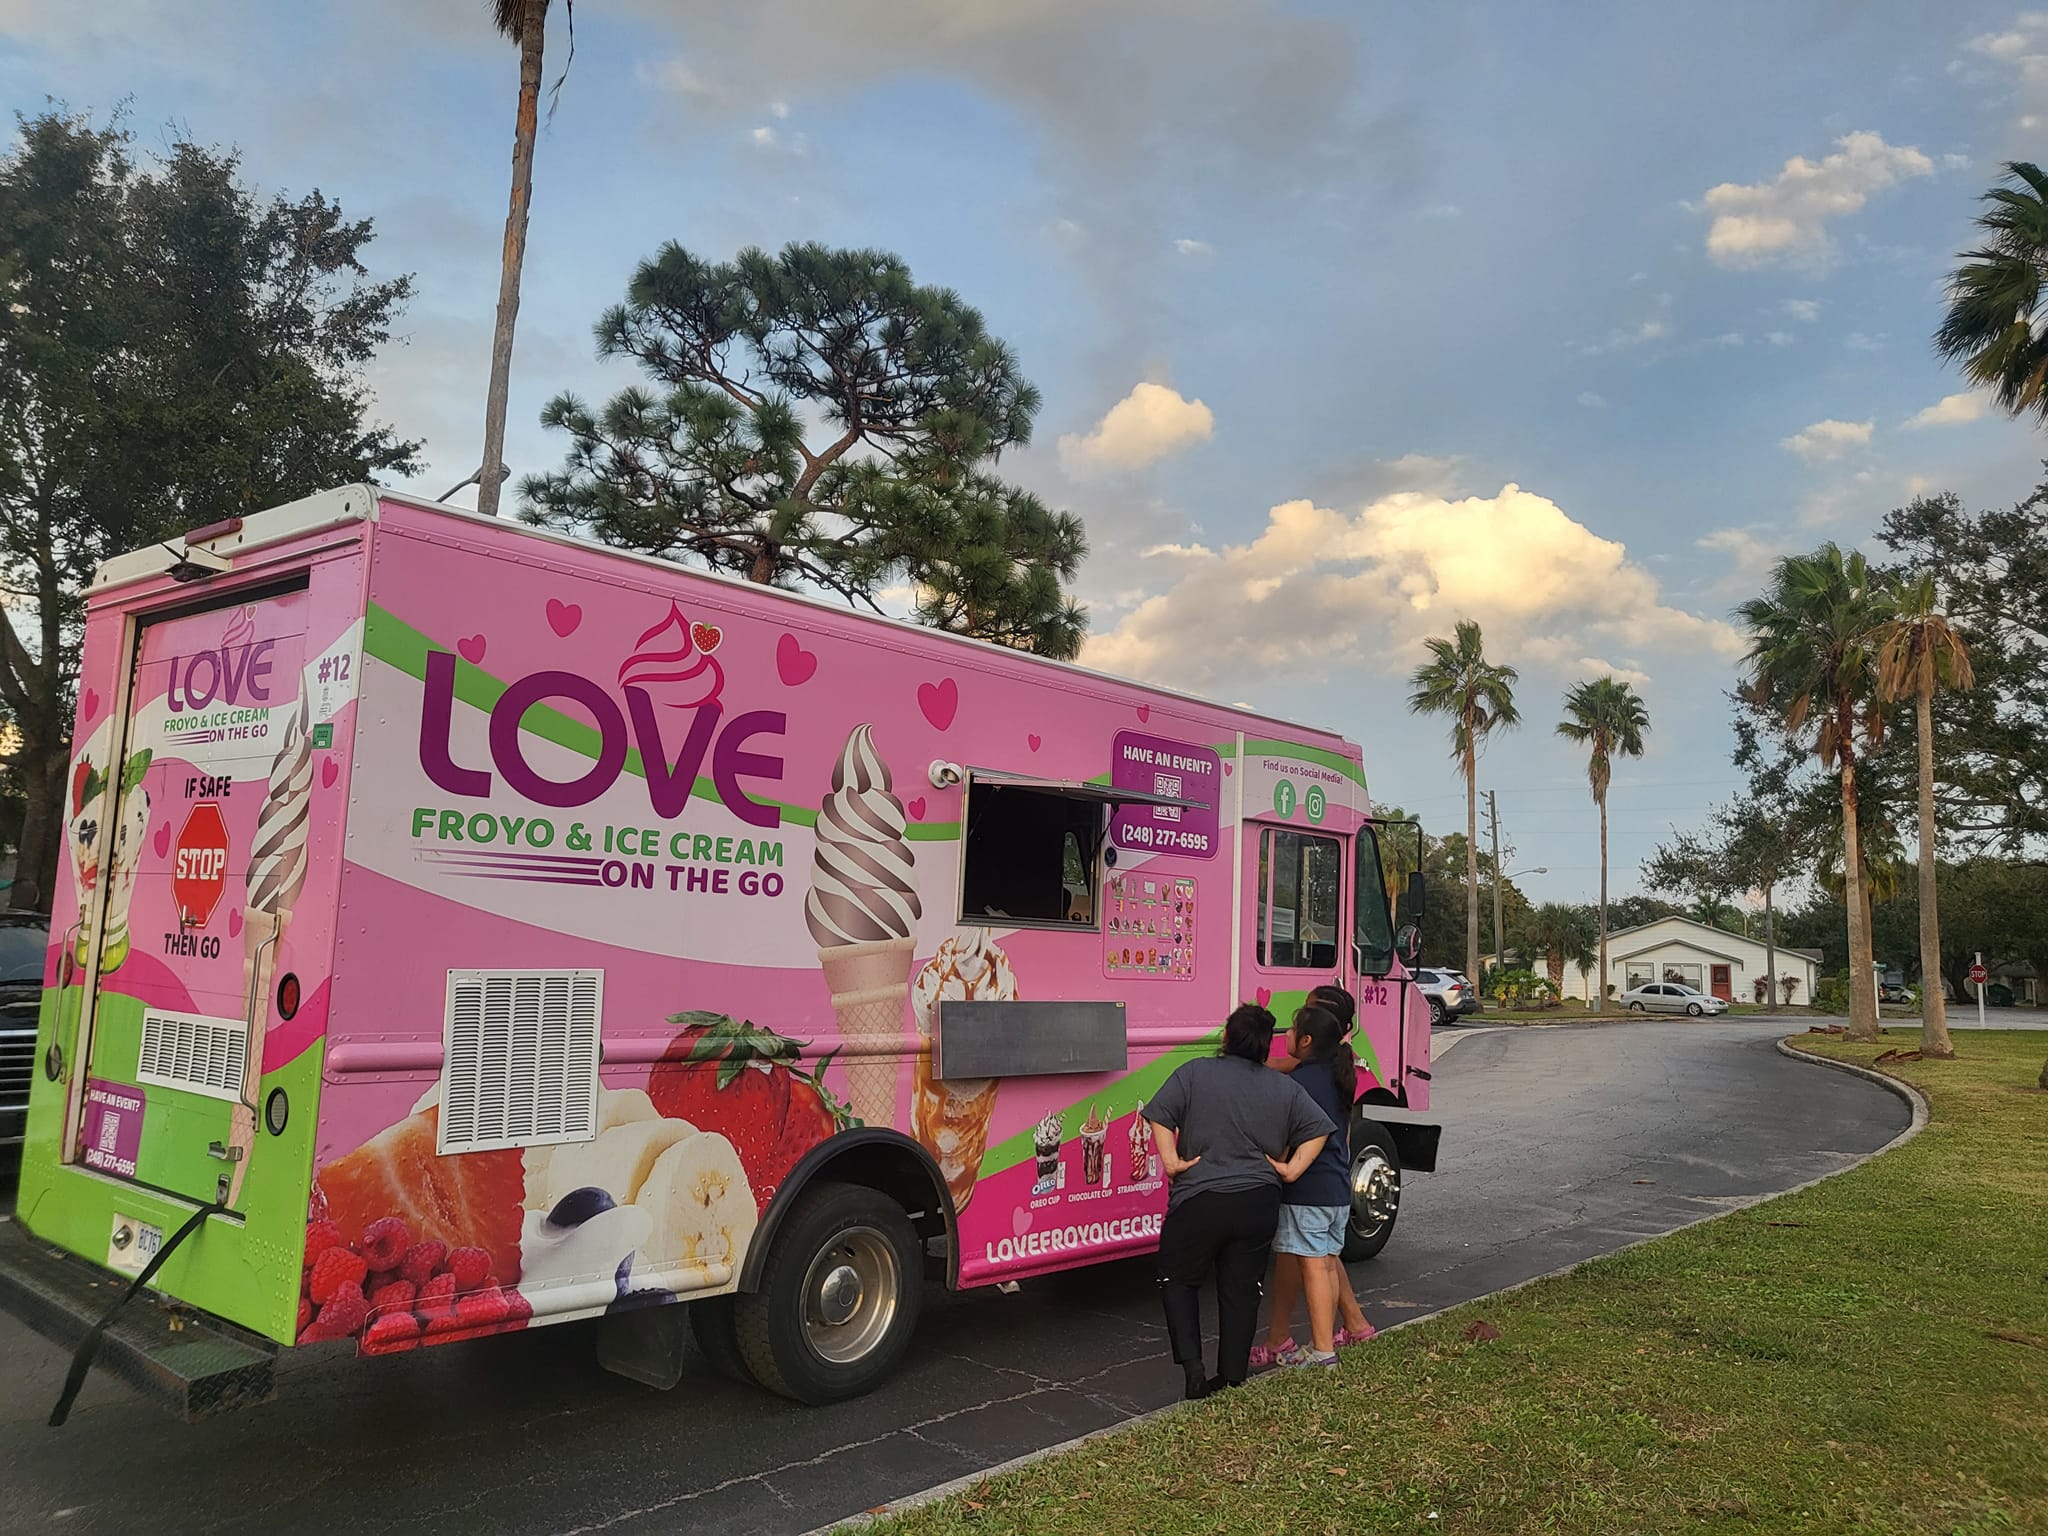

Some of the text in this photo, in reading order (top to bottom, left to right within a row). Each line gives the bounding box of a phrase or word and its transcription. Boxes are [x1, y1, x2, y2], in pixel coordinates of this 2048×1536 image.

[168, 639, 274, 713] LOVE
[318, 654, 351, 684] #12
[164, 708, 269, 732] FROYO & ICE CREAM
[209, 723, 268, 743] ON THE GO
[419, 650, 787, 829] LOVE
[1123, 745, 1213, 775] HAVE AN EVENT?
[1263, 759, 1343, 784] Find us on Social Media!
[185, 776, 231, 798] IF SAFE
[411, 808, 784, 867] FROYO & ICE CREAM
[1122, 823, 1208, 851] (248) 277-6595
[176, 848, 226, 880] STOP
[602, 860, 784, 897] ON THE GO
[164, 933, 221, 960] THEN GO
[1971, 970, 1986, 978] STOP
[1364, 985, 1388, 1006] #12
[89, 1089, 141, 1112] HAVE AN EVENT?
[103, 1153, 136, 1176] 277-6595
[1067, 1188, 1113, 1203] CHOCOLATE CUP
[1152, 1180, 1163, 1190] CUP
[1030, 1195, 1060, 1209] OREO CUP
